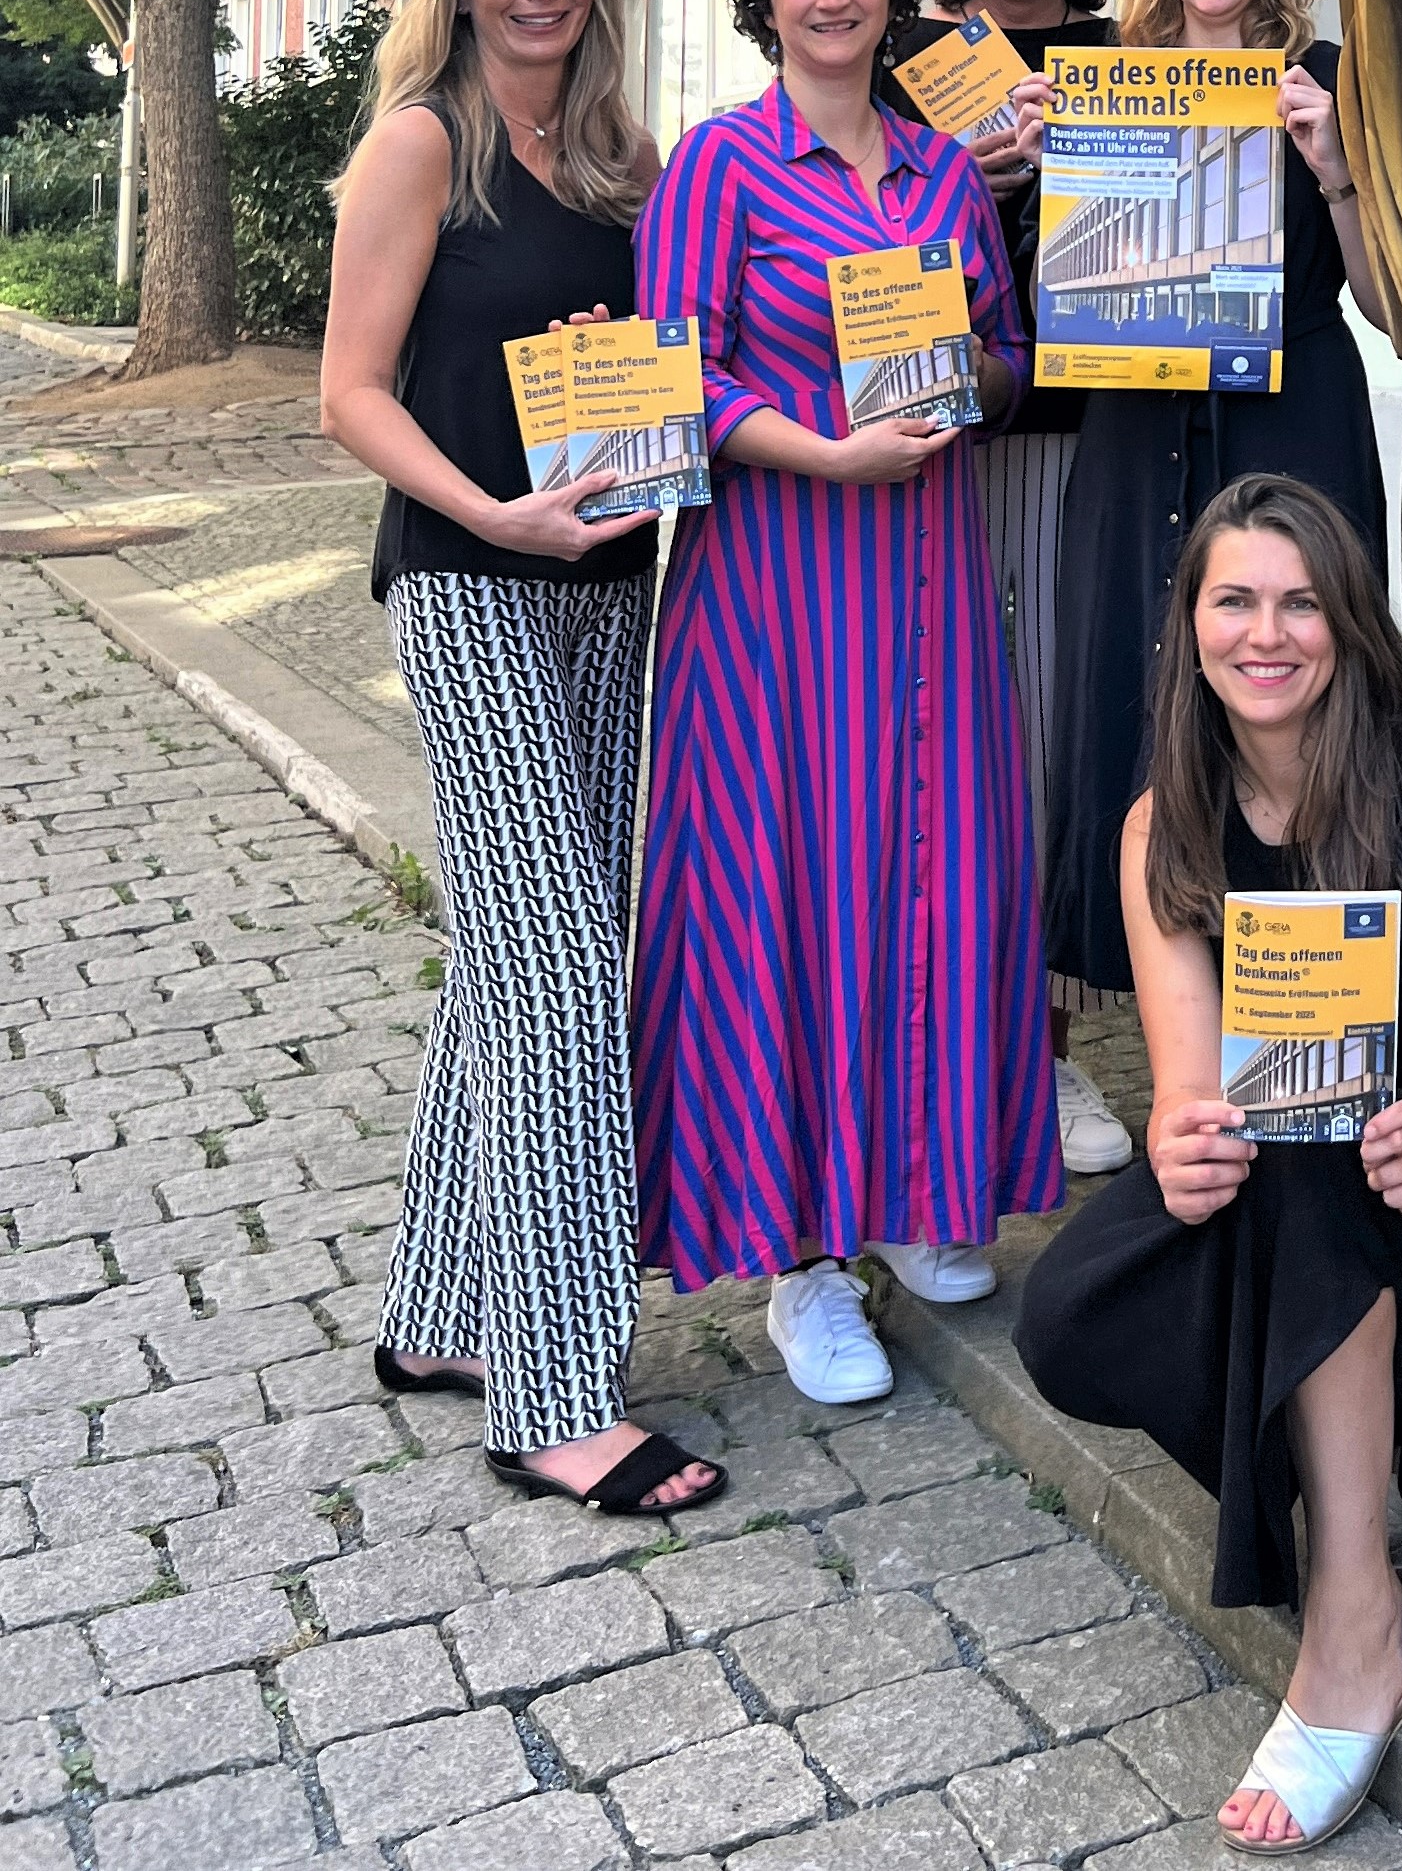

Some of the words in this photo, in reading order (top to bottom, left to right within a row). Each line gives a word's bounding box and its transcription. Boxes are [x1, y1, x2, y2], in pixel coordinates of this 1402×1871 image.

[1051, 58, 1099, 92] Tag
[1109, 58, 1156, 85] des
[1166, 59, 1277, 86] offenen
[1050, 126, 1117, 140] Bundesweite
[1119, 129, 1170, 143] Eröffnung
[1050, 139, 1075, 152] 14.9.
[1077, 142, 1090, 152] ab
[1093, 142, 1104, 153] 11
[1107, 142, 1126, 154] Uhr
[1128, 143, 1139, 154] in
[1140, 143, 1165, 154] Gera
[840, 291, 859, 302] Tag
[862, 288, 880, 299] des
[883, 281, 923, 295] offenen
[573, 360, 592, 372] Tag
[595, 358, 614, 369] des
[617, 356, 658, 367] offenen
[521, 373, 540, 384] Tag
[1235, 943, 1257, 962] Tag
[1262, 947, 1286, 962] des
[1290, 949, 1343, 962] offenen
